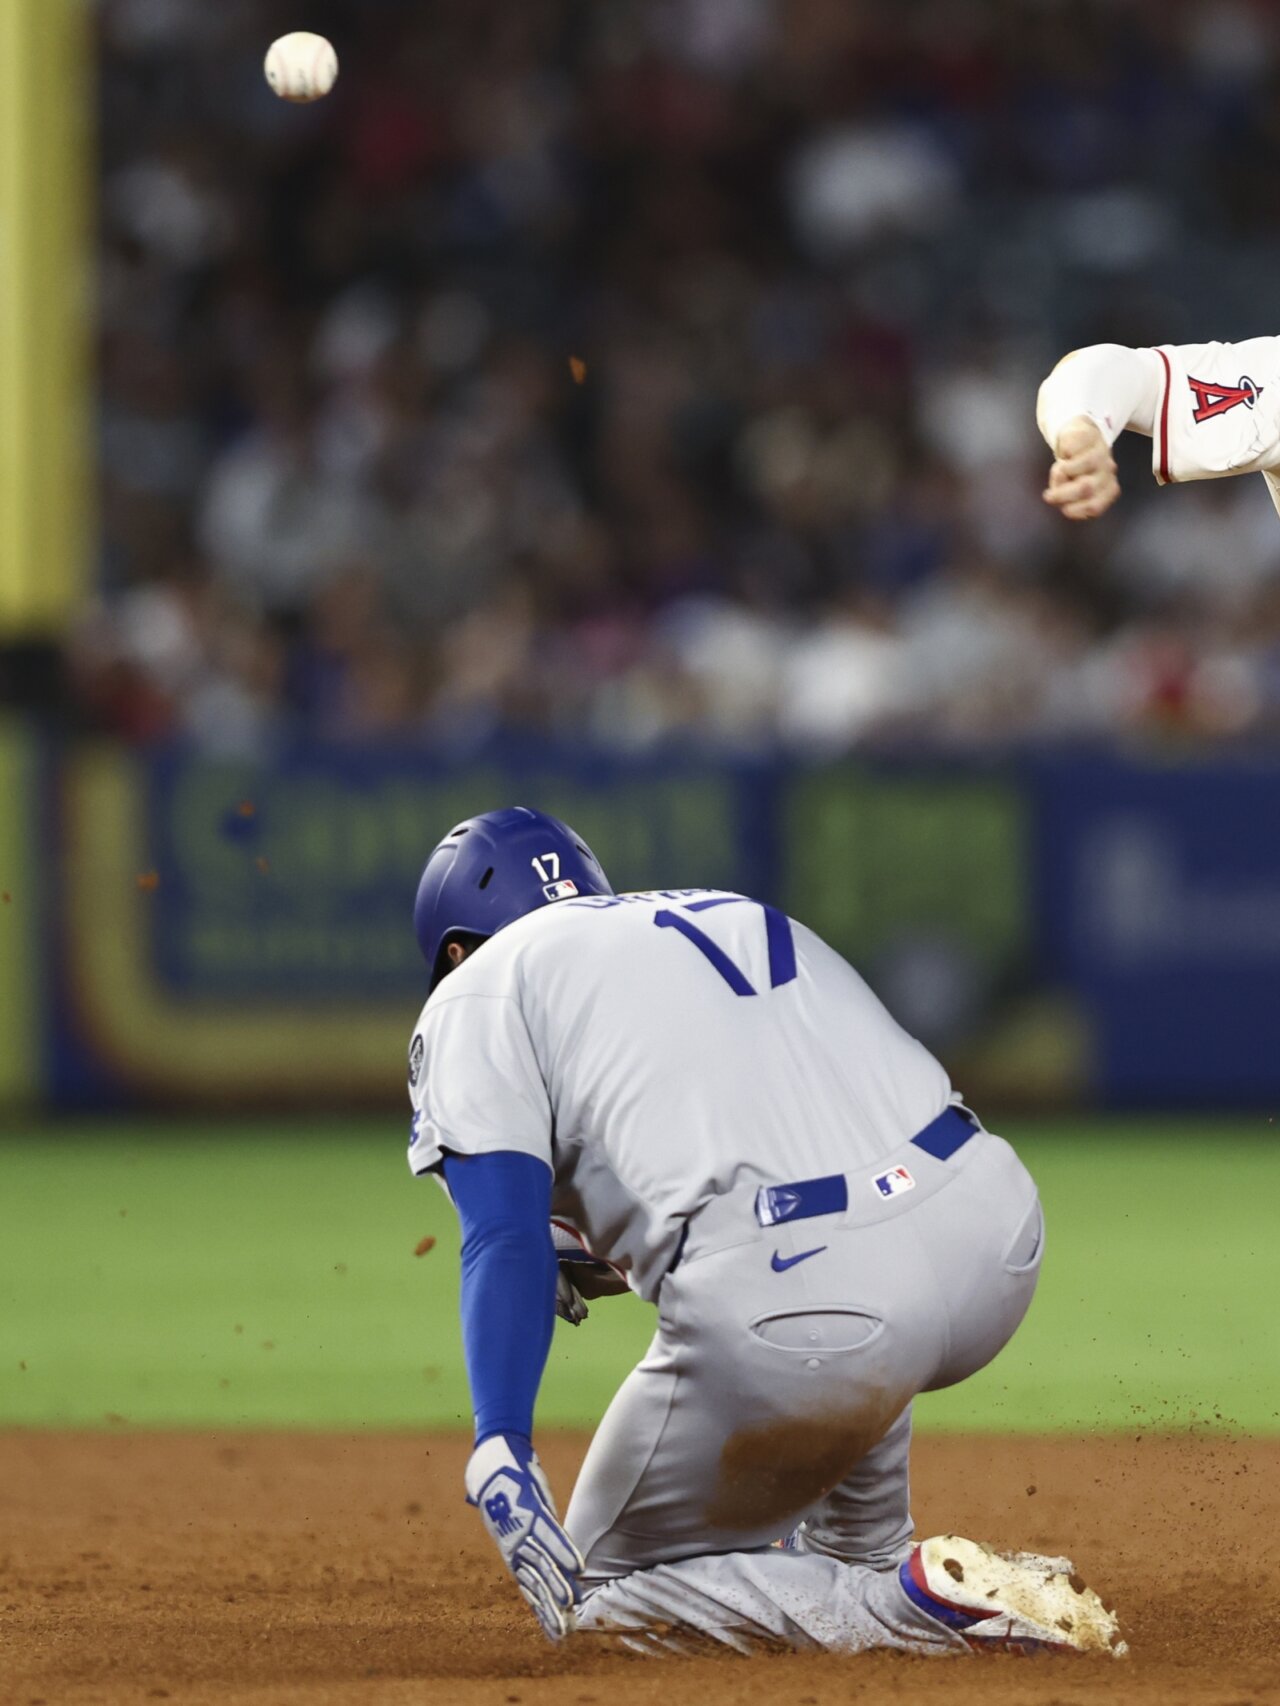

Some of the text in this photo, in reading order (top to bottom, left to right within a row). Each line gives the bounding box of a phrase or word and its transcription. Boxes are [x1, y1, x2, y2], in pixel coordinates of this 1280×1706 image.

[1187, 375, 1264, 424] A
[531, 852, 560, 882] 17
[654, 897, 798, 996] 17
